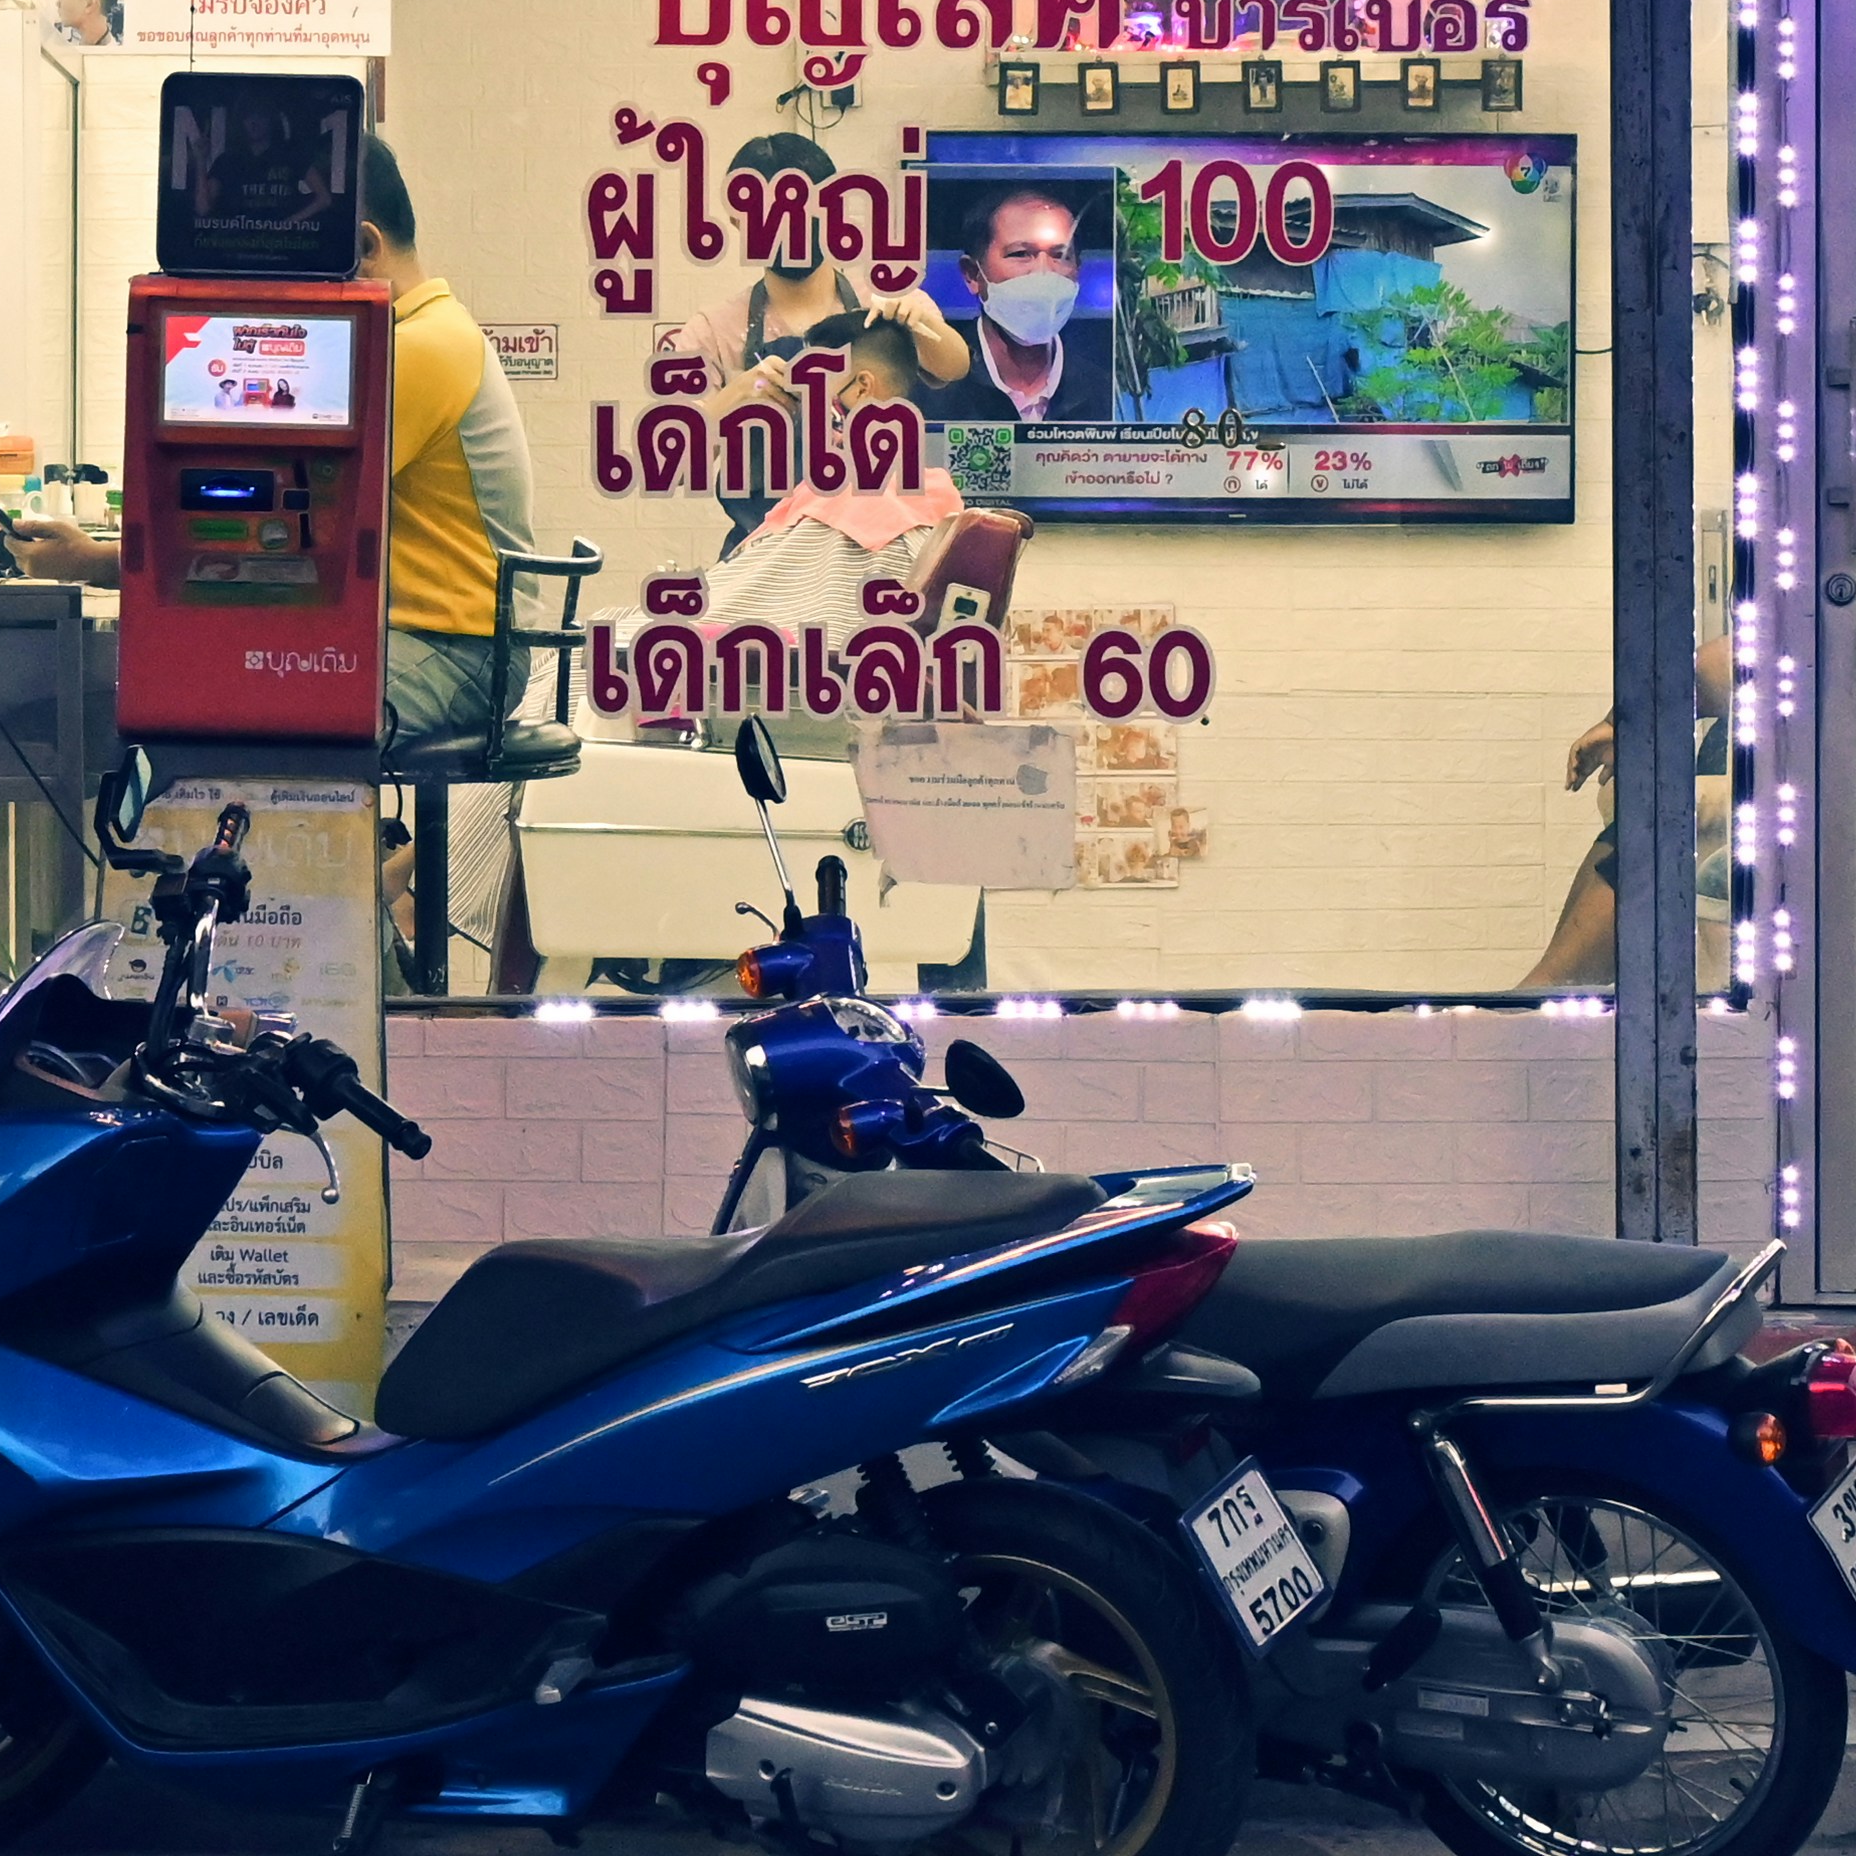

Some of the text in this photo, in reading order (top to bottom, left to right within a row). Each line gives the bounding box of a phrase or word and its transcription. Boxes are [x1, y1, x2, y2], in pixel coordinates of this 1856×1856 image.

[585, 106, 1334, 316] ผู้ใหญ่ 100
[482, 328, 553, 354] ้ามเข้า
[499, 355, 554, 370] ้รับอนุญาต
[590, 350, 926, 498] เด็กโต
[1035, 447, 1099, 465] คุณคิดว่า
[1226, 449, 1284, 472] 77%
[1314, 450, 1373, 472] 23%
[1065, 470, 1161, 486] เข้าออกหรือไม่
[586, 572, 1217, 725] เด็กเล็ก 60
[265, 646, 358, 679] บุญเติม
[210, 1244, 289, 1263] เติม Wallet
[198, 1262, 300, 1286] และซื้อรหัสบัตร
[258, 1303, 319, 1326] เลขเด็ด
[1221, 1522, 1296, 1597] กรุงเทพมหานคร
[1248, 1565, 1313, 1637] 5700
